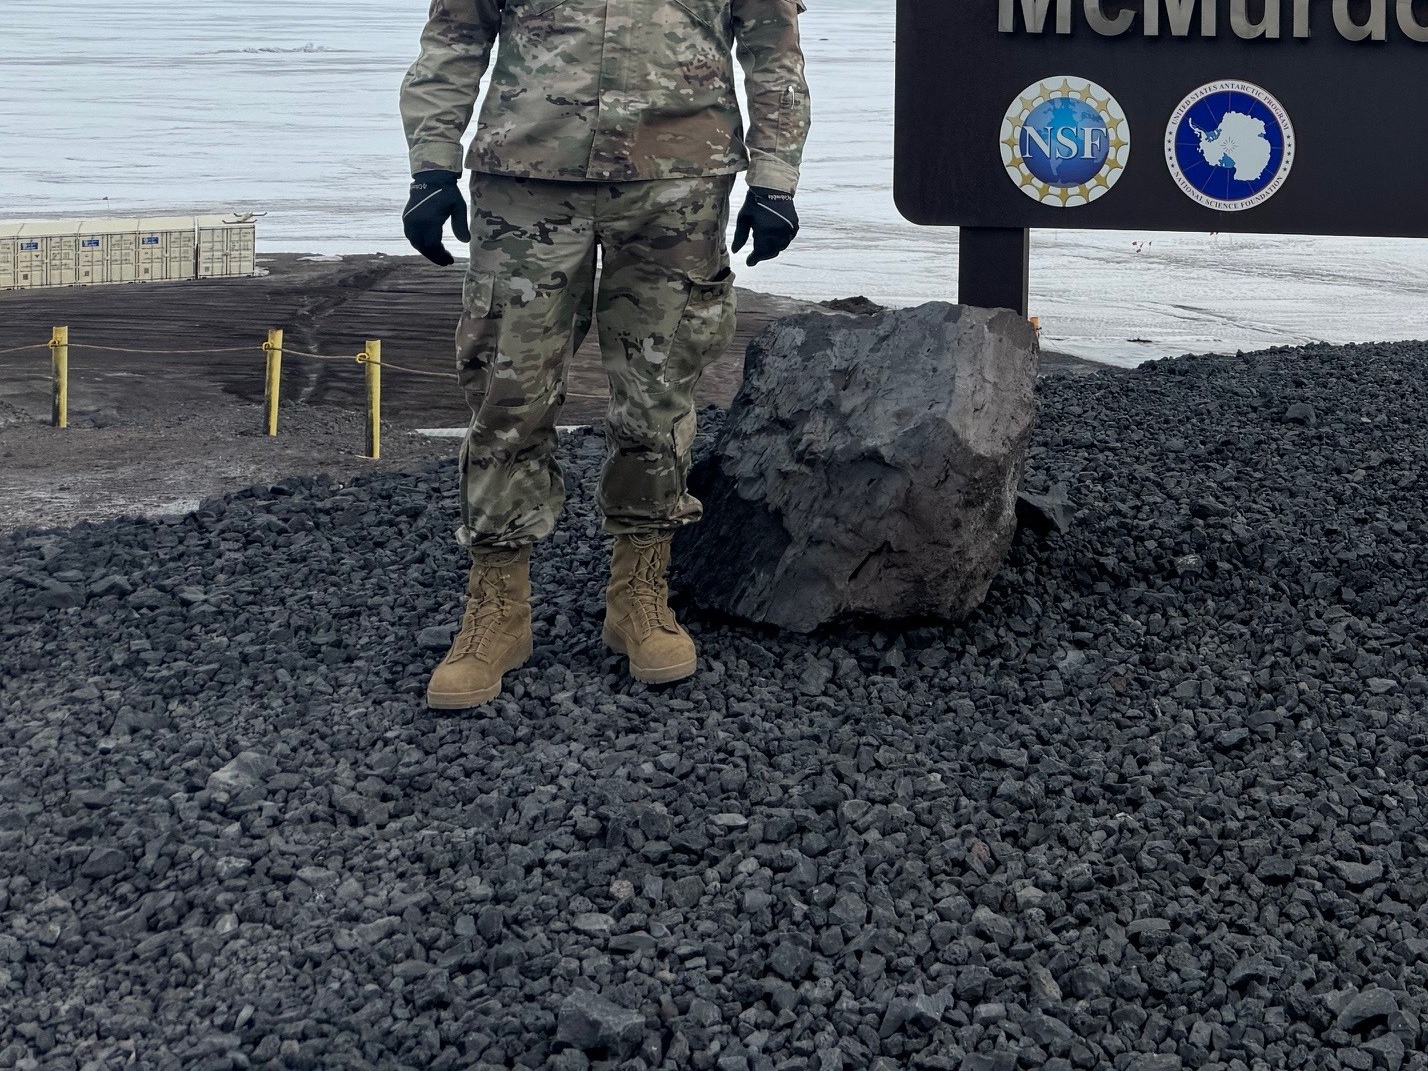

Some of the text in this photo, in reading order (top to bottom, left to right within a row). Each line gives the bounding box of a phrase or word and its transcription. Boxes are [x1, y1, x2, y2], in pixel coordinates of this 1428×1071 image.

[1172, 83, 1290, 130] UNITED STATES ANTARCTIC PROGRAM
[1022, 125, 1107, 159] NSF
[1174, 171, 1283, 209] NATIONAL SCIENCE FOUNDATION
